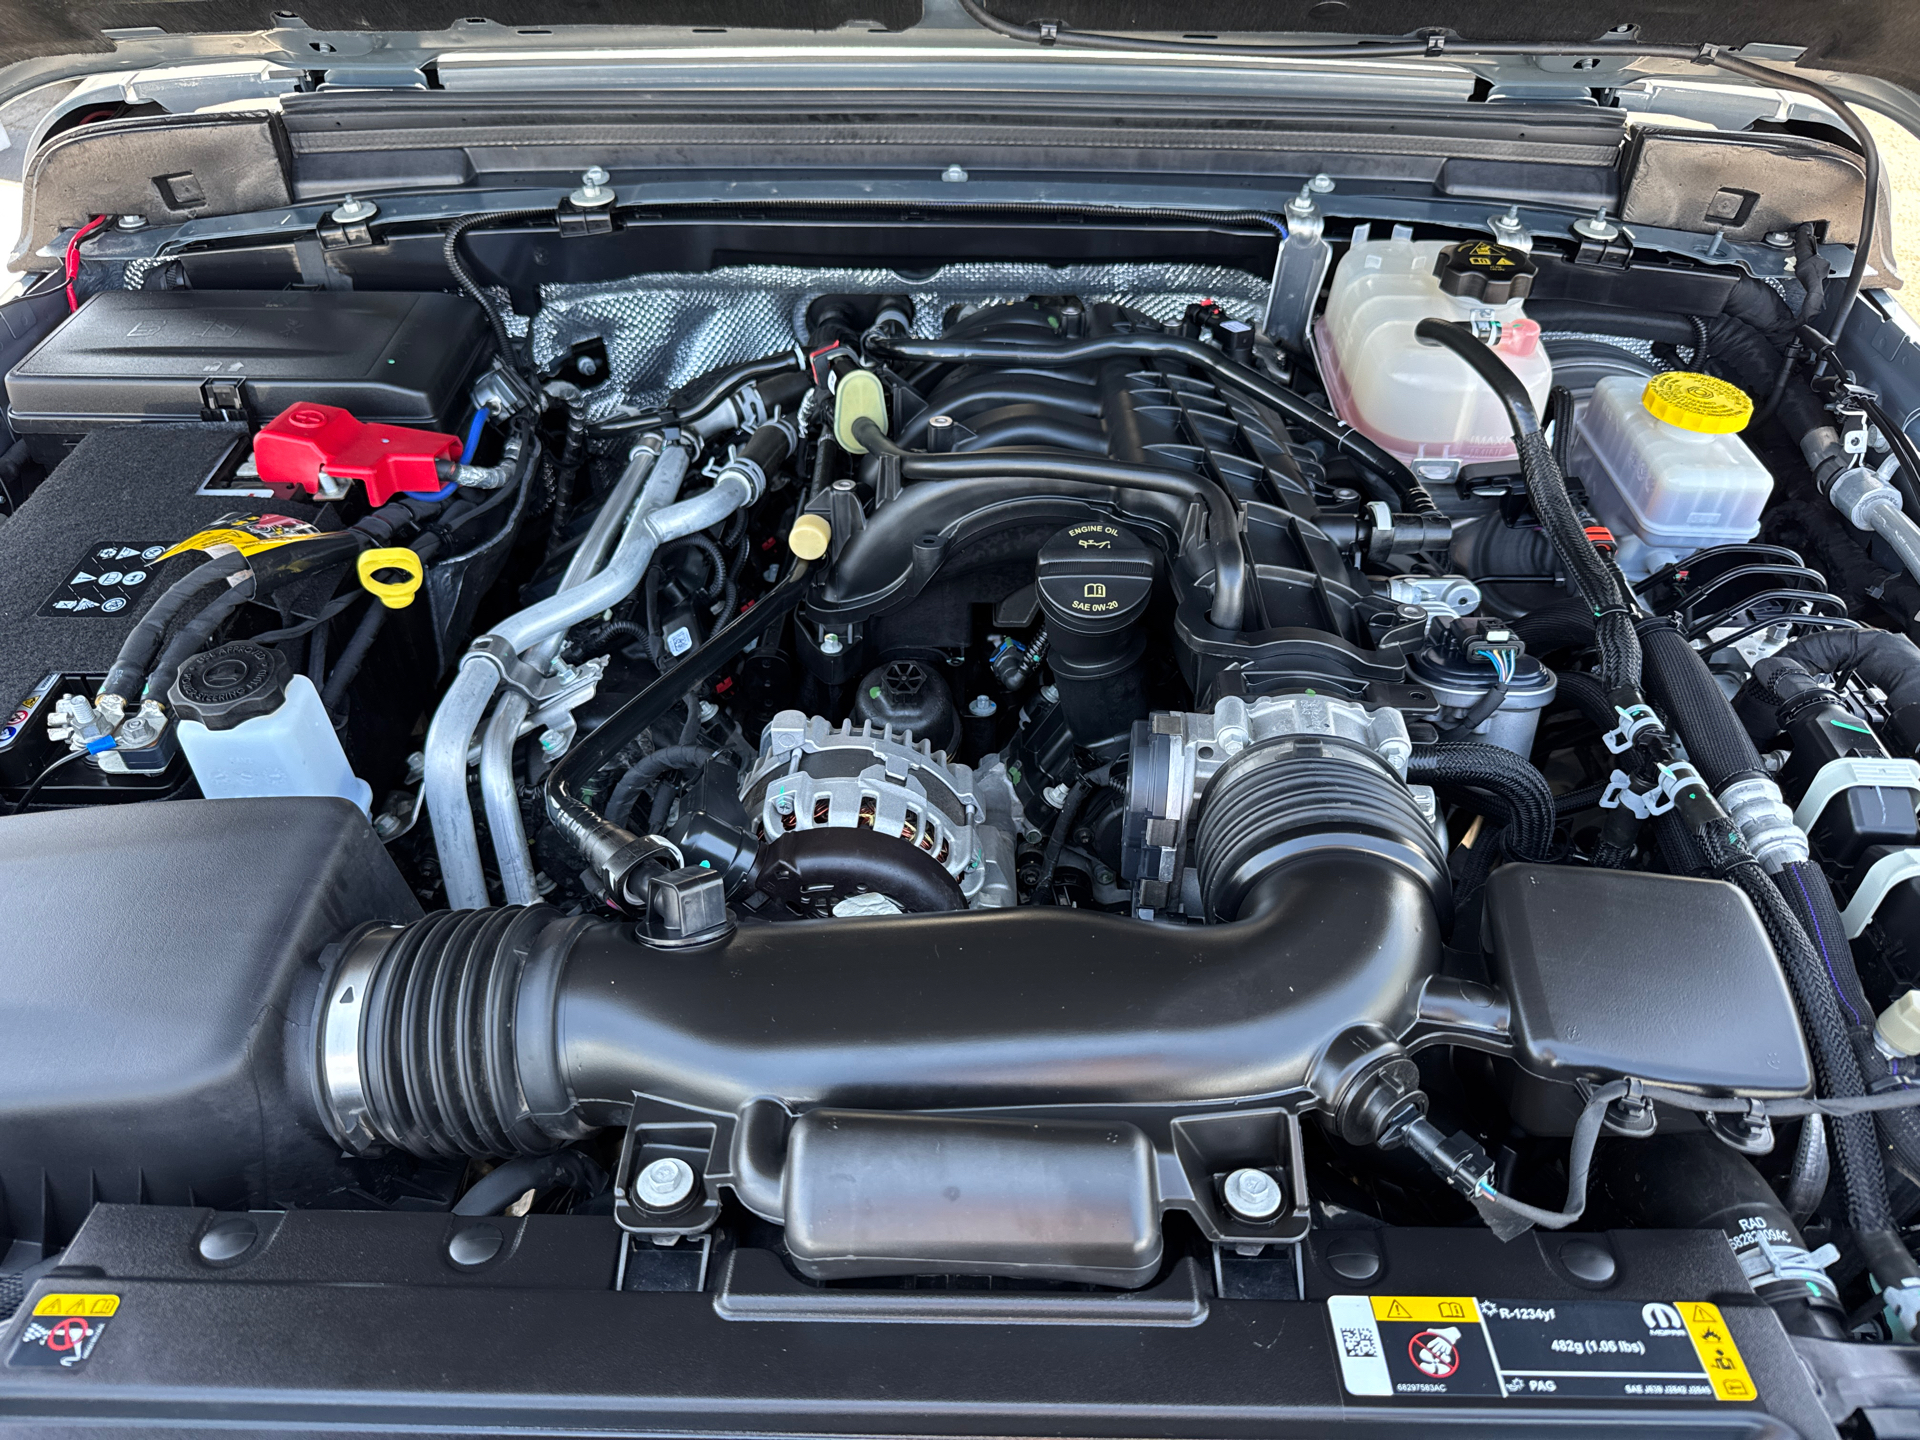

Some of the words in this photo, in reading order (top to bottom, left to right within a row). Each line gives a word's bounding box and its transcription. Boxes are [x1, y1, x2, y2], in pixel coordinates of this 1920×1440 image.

[1068, 525, 1103, 537] ENGINE
[1104, 526, 1119, 537] OIL
[1071, 600, 1091, 611] SAE
[1092, 600, 1119, 612] 0W-20
[196, 652, 216, 664] USE
[219, 645, 266, 661] APPROVED
[181, 672, 198, 698] POWER
[195, 686, 246, 702] STEERING
[246, 668, 267, 690] FLUID
[1738, 1216, 1767, 1231] RAD
[1649, 1328, 1687, 1337] MOPAR
[1551, 1339, 1585, 1355] 482g
[1619, 1340, 1646, 1356] lbs)
[1528, 1380, 1557, 1392] PAG
[1624, 1384, 1643, 1394] SAE
